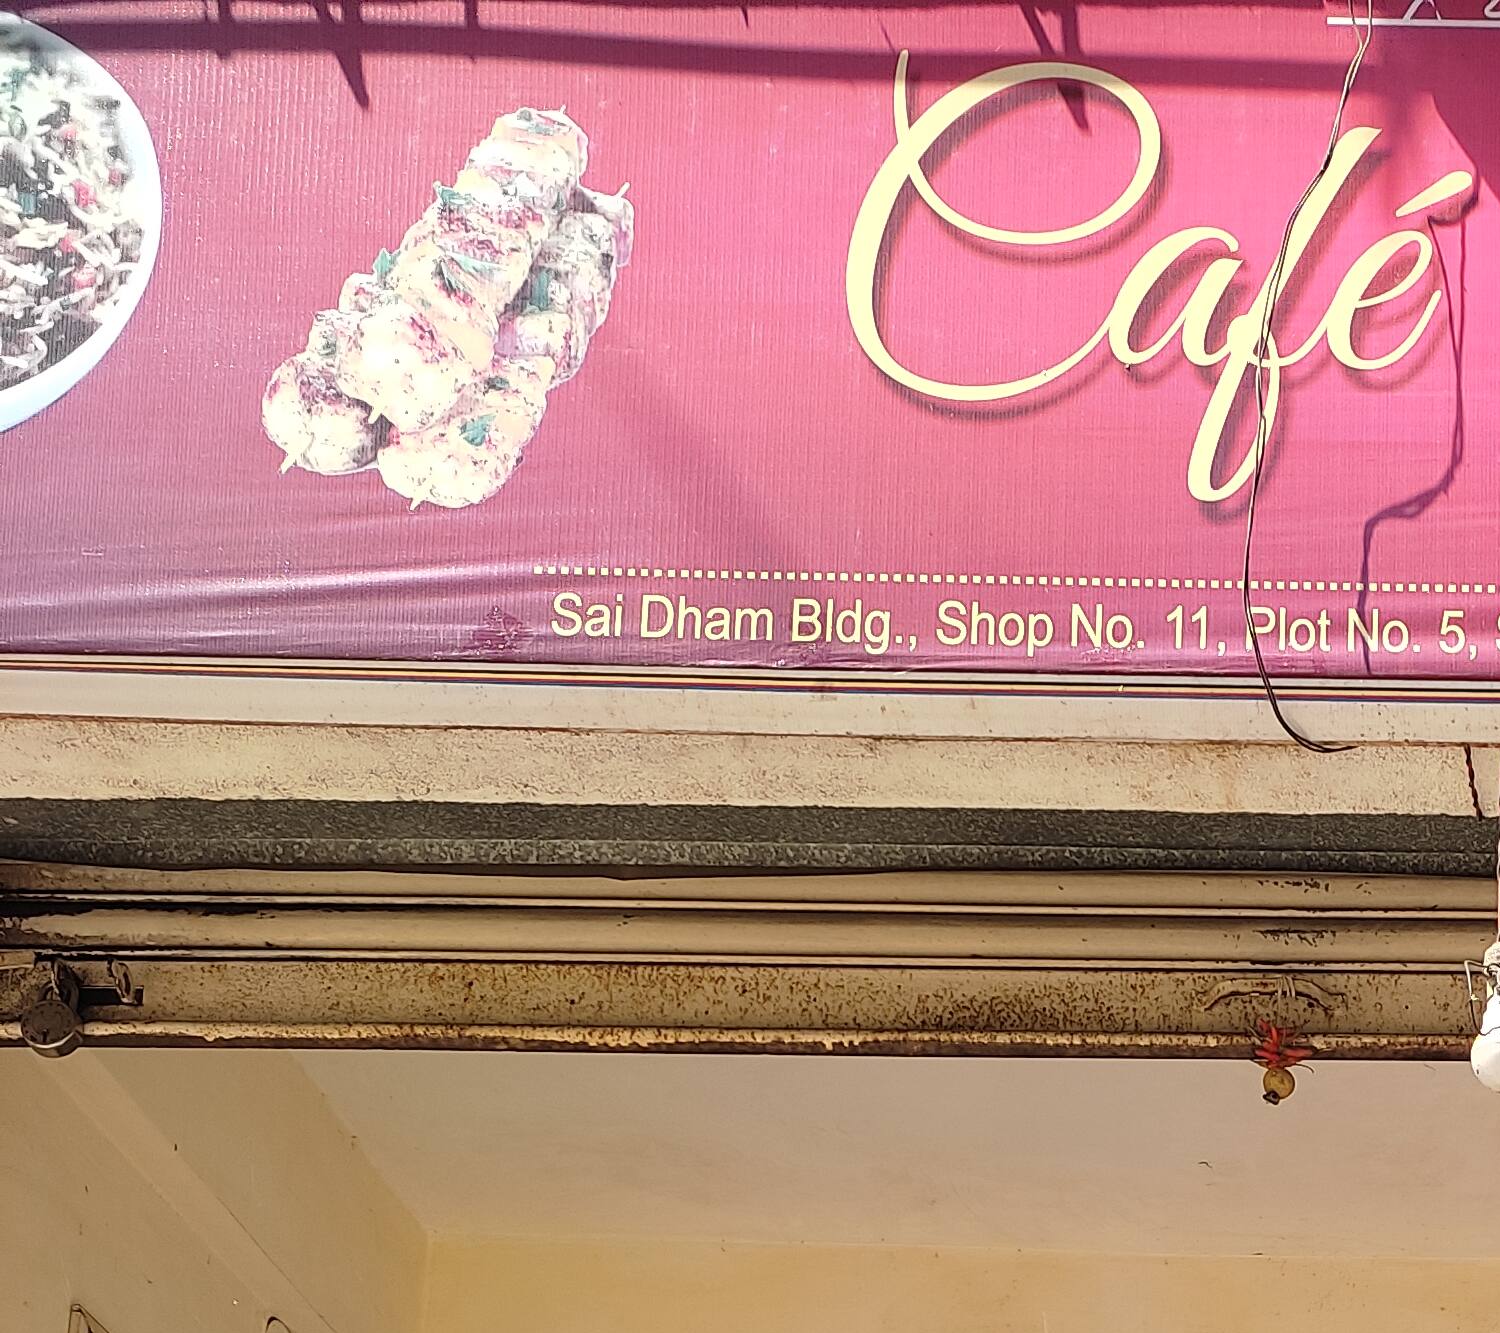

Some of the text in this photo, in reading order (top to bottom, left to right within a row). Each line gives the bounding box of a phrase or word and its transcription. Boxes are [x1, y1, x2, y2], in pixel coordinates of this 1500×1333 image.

[844, 49, 1474, 503] Café
[551, 592, 623, 637] Sai
[640, 594, 774, 641] Dham
[791, 598, 917, 655] Bldg.,
[936, 600, 1053, 657] Shop
[1071, 604, 1145, 649] No.
[1167, 605, 1226, 656] 11,
[1245, 606, 1331, 653] Plot
[1347, 608, 1421, 654] No.
[1439, 610, 1478, 660] 5,
